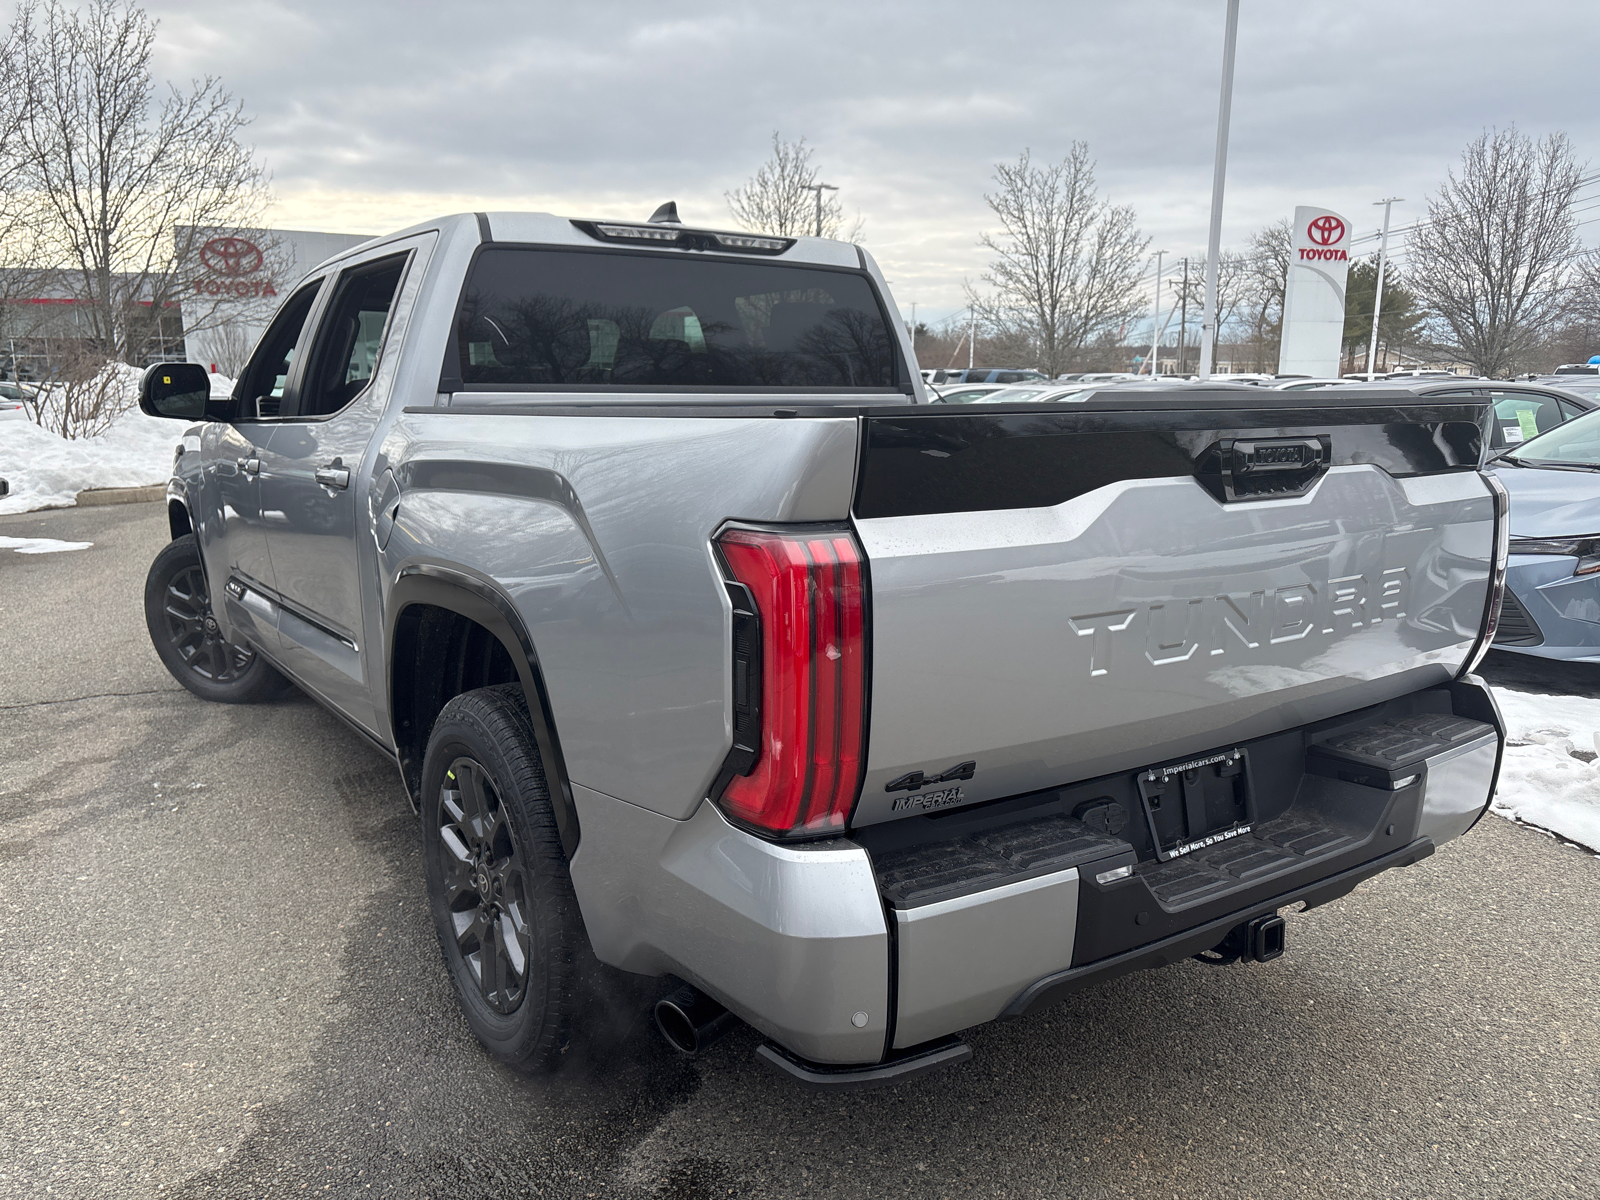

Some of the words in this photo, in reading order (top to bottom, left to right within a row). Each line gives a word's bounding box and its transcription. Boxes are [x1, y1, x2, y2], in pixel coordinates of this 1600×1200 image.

[1299, 248, 1348, 261] TOYOTA
[194, 280, 277, 297] TOYOTA
[1259, 447, 1300, 463] TOYOTA
[1068, 566, 1411, 676] TUNDRA
[1162, 755, 1226, 775] Imperialcars.com
[892, 787, 964, 811] IMPERIAL
[1169, 849, 1179, 858] We
[1179, 845, 1190, 855] Sell
[1190, 841, 1205, 851] More,
[1206, 837, 1214, 845] So
[1214, 834, 1224, 842] You
[1224, 831, 1237, 839] Save
[1237, 826, 1251, 835] More
